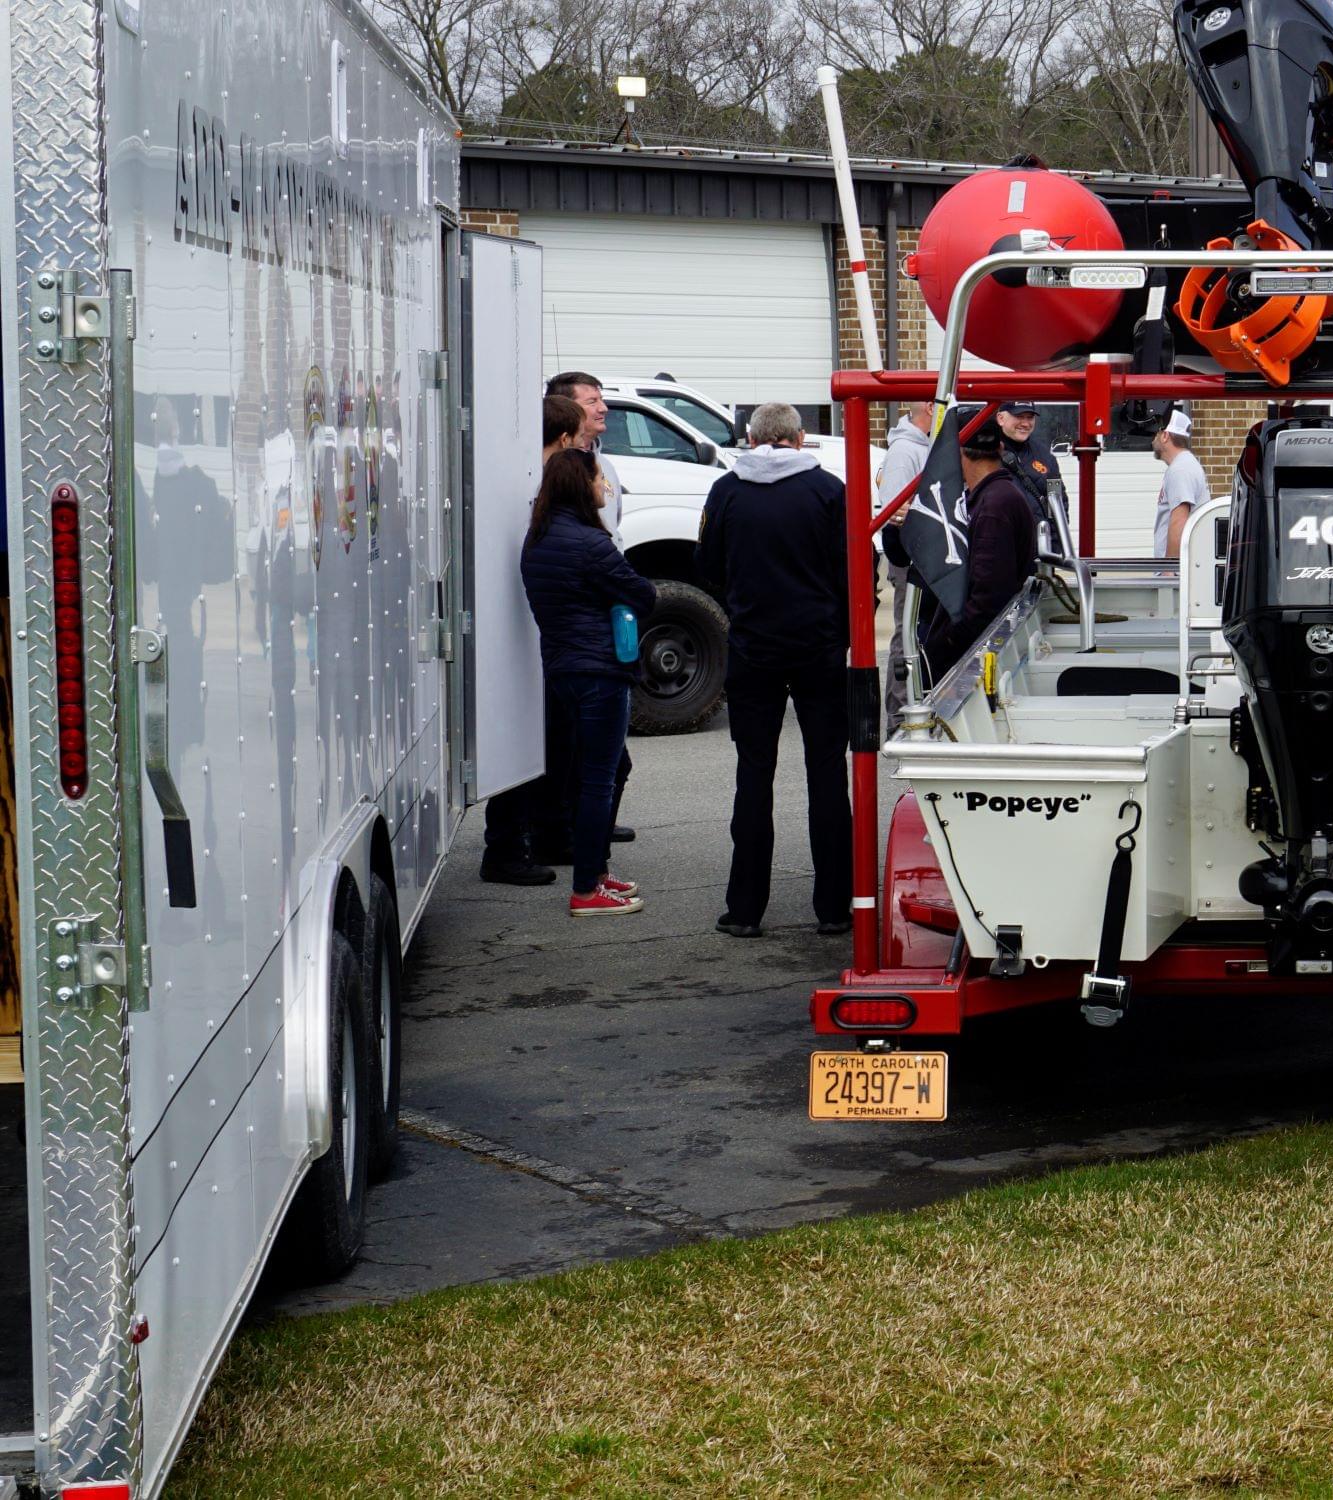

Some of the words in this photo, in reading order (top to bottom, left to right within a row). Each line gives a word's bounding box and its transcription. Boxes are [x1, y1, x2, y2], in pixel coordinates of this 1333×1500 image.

[818, 1058, 865, 1069] NORTH
[871, 1058, 940, 1069] CAROLINA
[825, 1071, 931, 1104] 24397-W
[847, 1107, 908, 1115] PERMANENT
